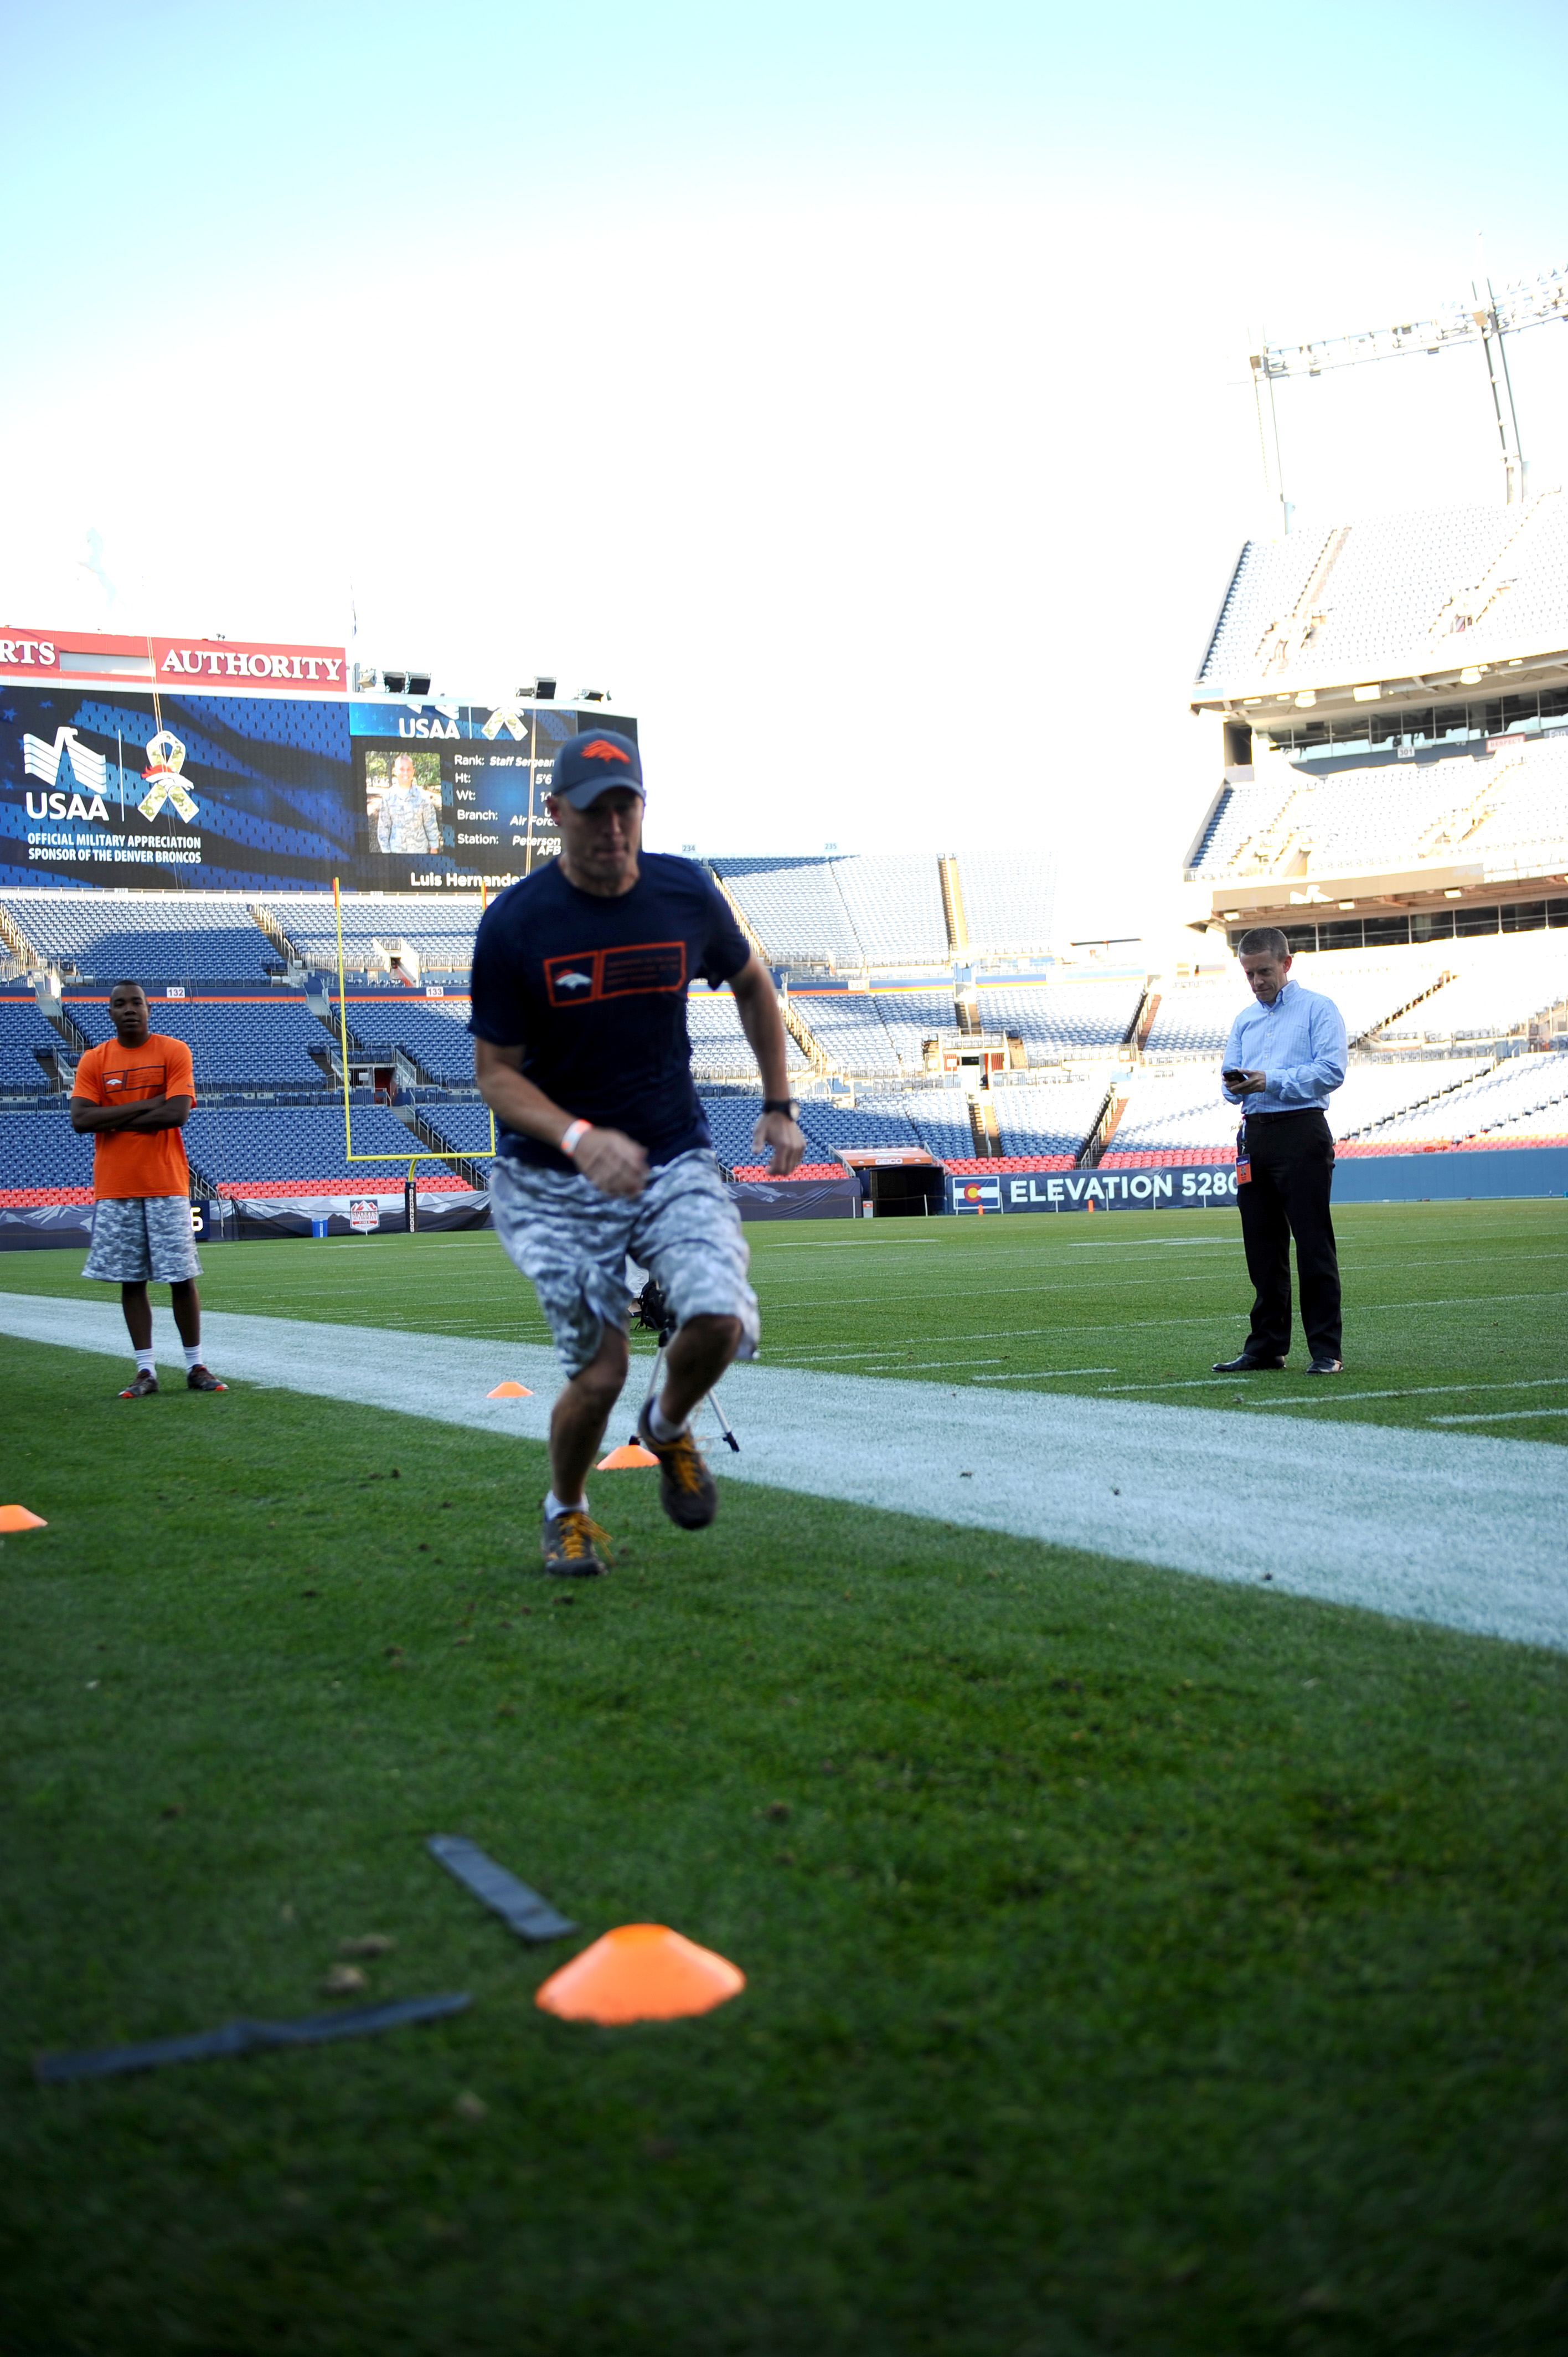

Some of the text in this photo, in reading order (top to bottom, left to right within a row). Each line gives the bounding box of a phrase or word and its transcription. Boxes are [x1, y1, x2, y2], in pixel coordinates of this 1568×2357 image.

[161, 649, 343, 681] AUTHORITY
[399, 718, 461, 739] USAA
[454, 754, 555, 768] Rank: Staff Sergean
[455, 773, 471, 784] Ht:
[456, 790, 476, 801] Wt:
[26, 792, 110, 821] USAA
[457, 809, 498, 821] Branch:
[509, 815, 527, 826] Air
[28, 832, 201, 849] OFFICIAL MILITARY APPRECIATION
[457, 833, 499, 845] Station:
[512, 835, 561, 846] Peterson
[28, 848, 202, 864] SPONSOR OF THE DENVER BRONCOS
[537, 846, 561, 856] AFB
[411, 872, 442, 886] Luis
[1010, 1171, 1238, 1203] ELEVATION 5280
